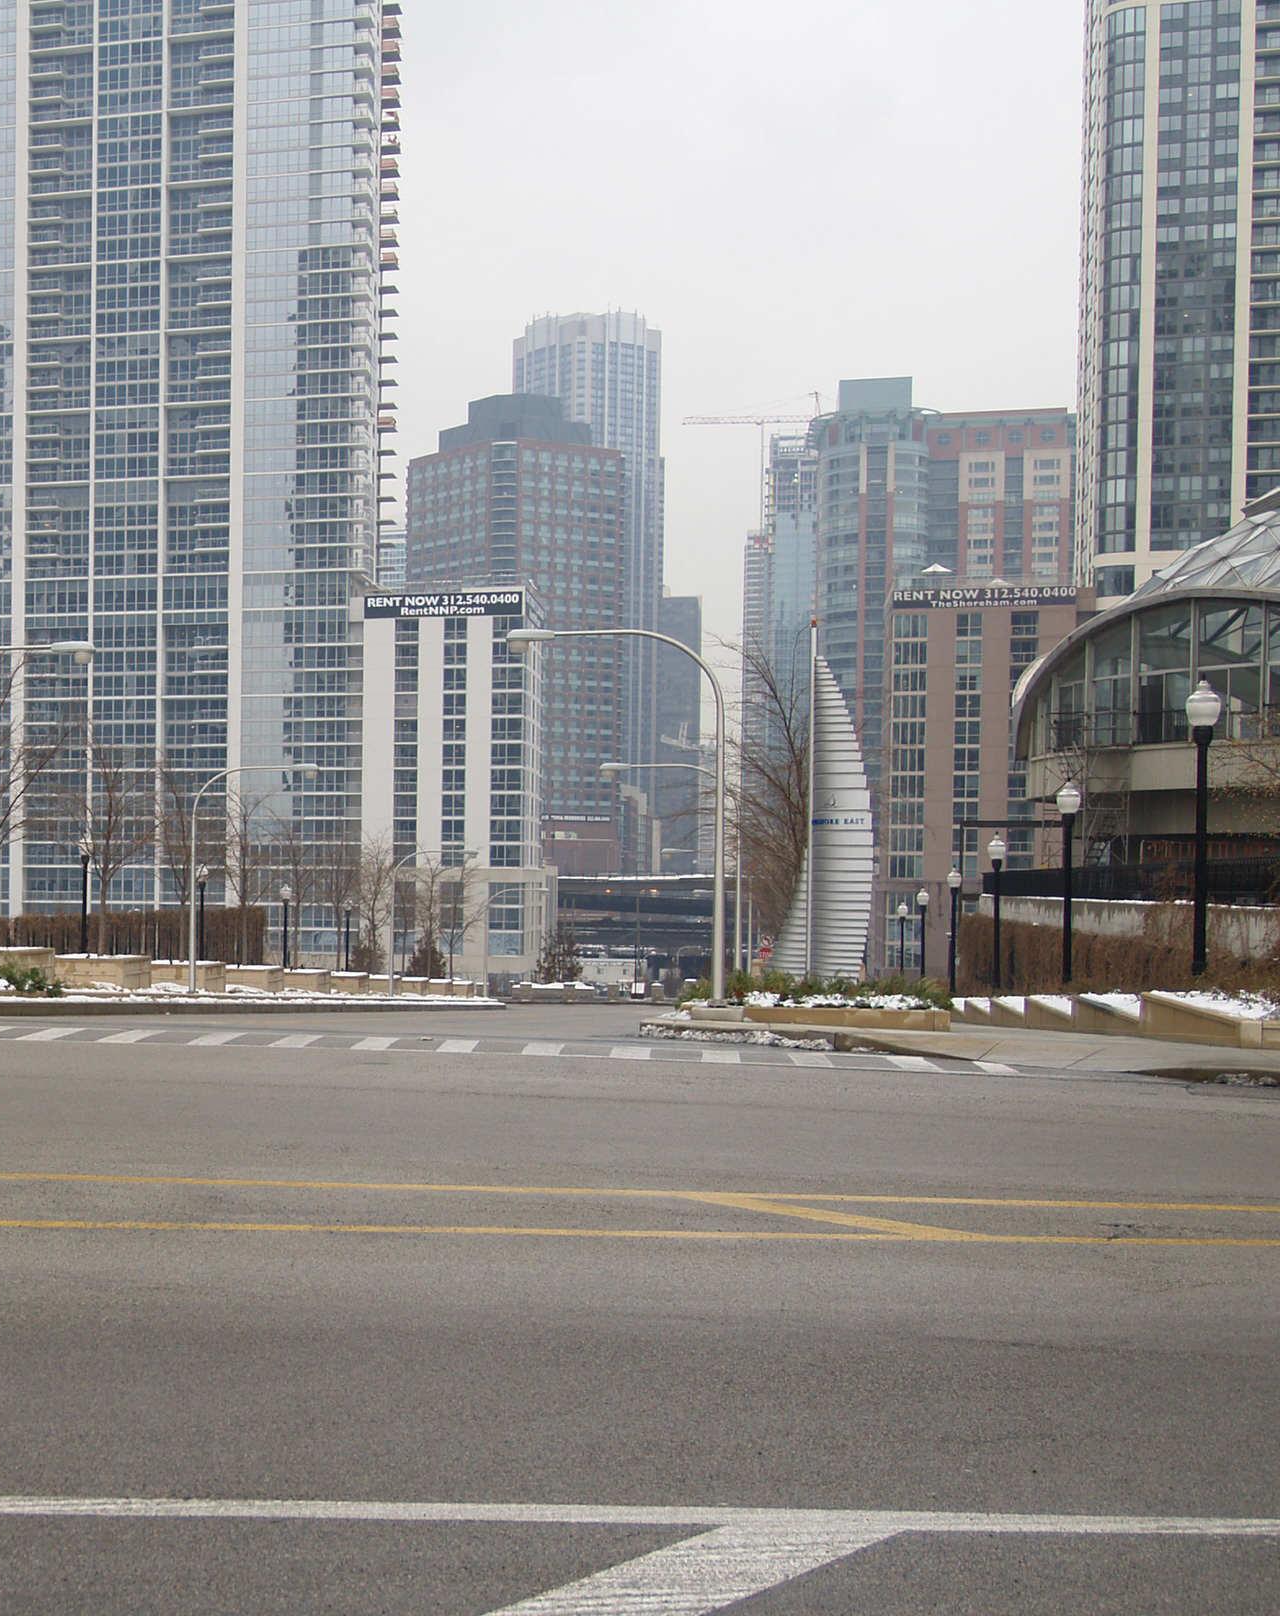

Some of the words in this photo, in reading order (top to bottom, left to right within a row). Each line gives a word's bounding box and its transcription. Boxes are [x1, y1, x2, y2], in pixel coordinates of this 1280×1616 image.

[367, 597, 405, 607] RENT
[406, 596, 439, 606] NOW
[442, 593, 519, 606] 312.540.0400
[893, 590, 934, 601] RENT
[939, 589, 979, 600] NOW
[984, 587, 1076, 599] 312.540.0400
[400, 605, 485, 616] RentNNP.com
